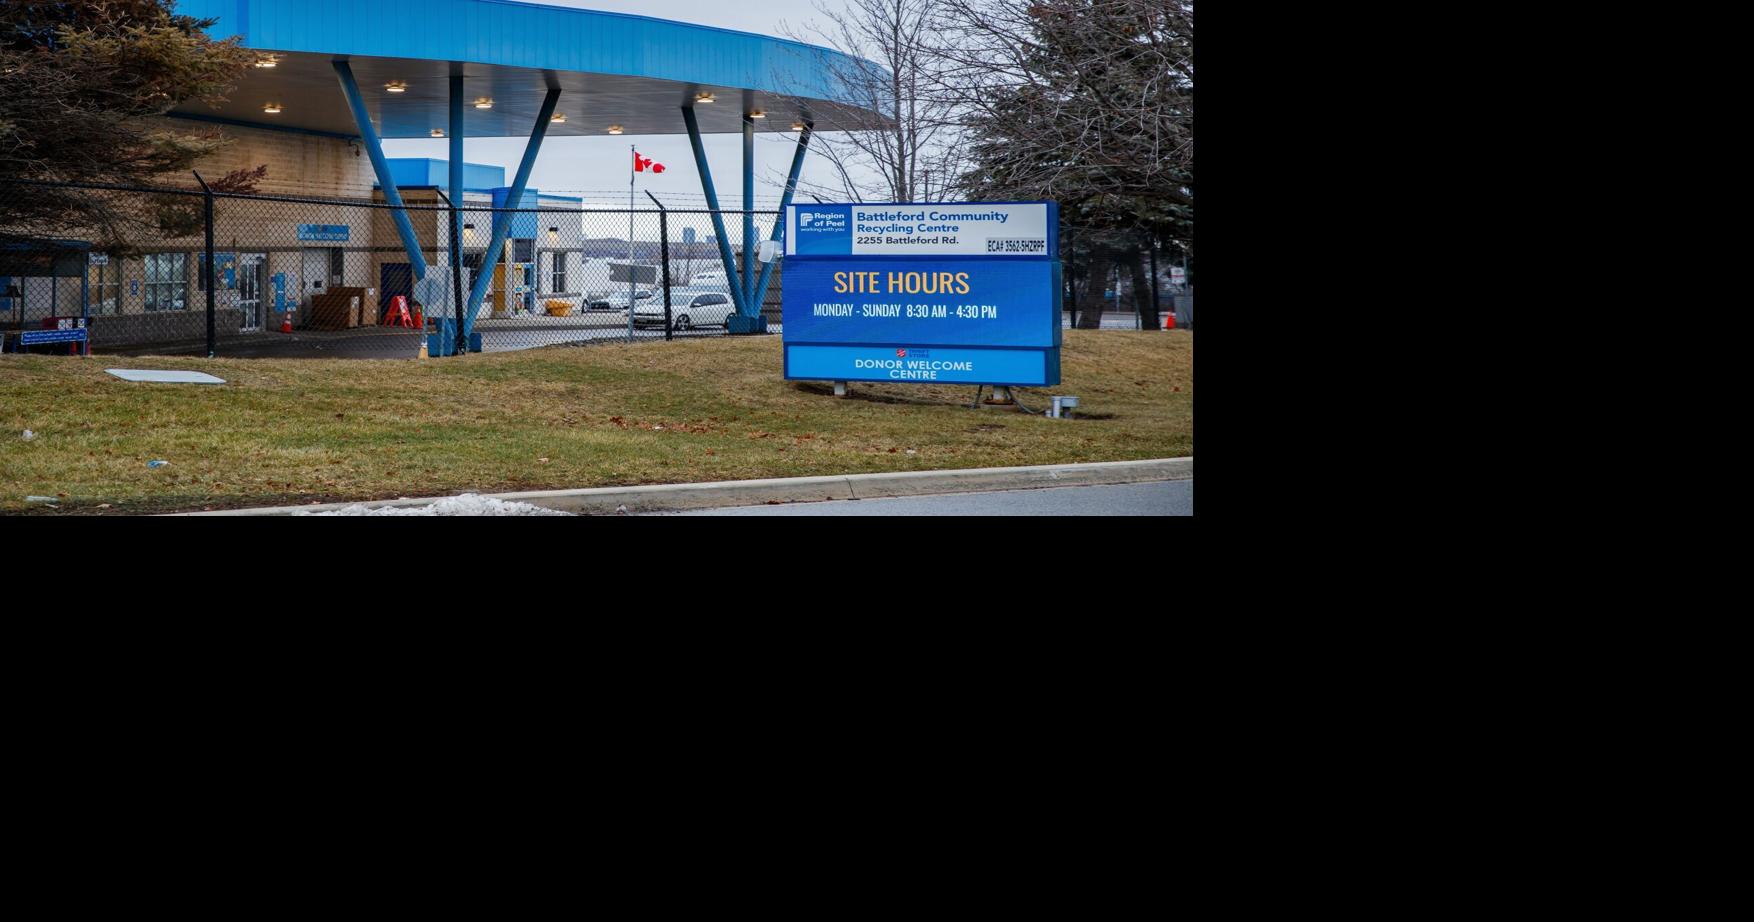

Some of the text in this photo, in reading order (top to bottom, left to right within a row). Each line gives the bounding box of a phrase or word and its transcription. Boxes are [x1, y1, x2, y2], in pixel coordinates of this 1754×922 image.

[814, 212, 845, 220] Region
[857, 211, 1008, 223] Battleford Community
[857, 223, 959, 235] Recycling Centre
[856, 236, 959, 245] 2255 Battleford Rd.
[987, 240, 1004, 252] ECA#
[834, 271, 970, 295] SITE HOURS
[813, 303, 853, 317] MONDAY
[862, 304, 901, 318] SUNDAY
[906, 304, 928, 318] 8:30
[931, 305, 947, 318] AM
[956, 305, 979, 319] 4:30
[981, 306, 997, 319] PM
[855, 359, 973, 371] DONOR WELCOME
[889, 369, 937, 380] CENTRE
